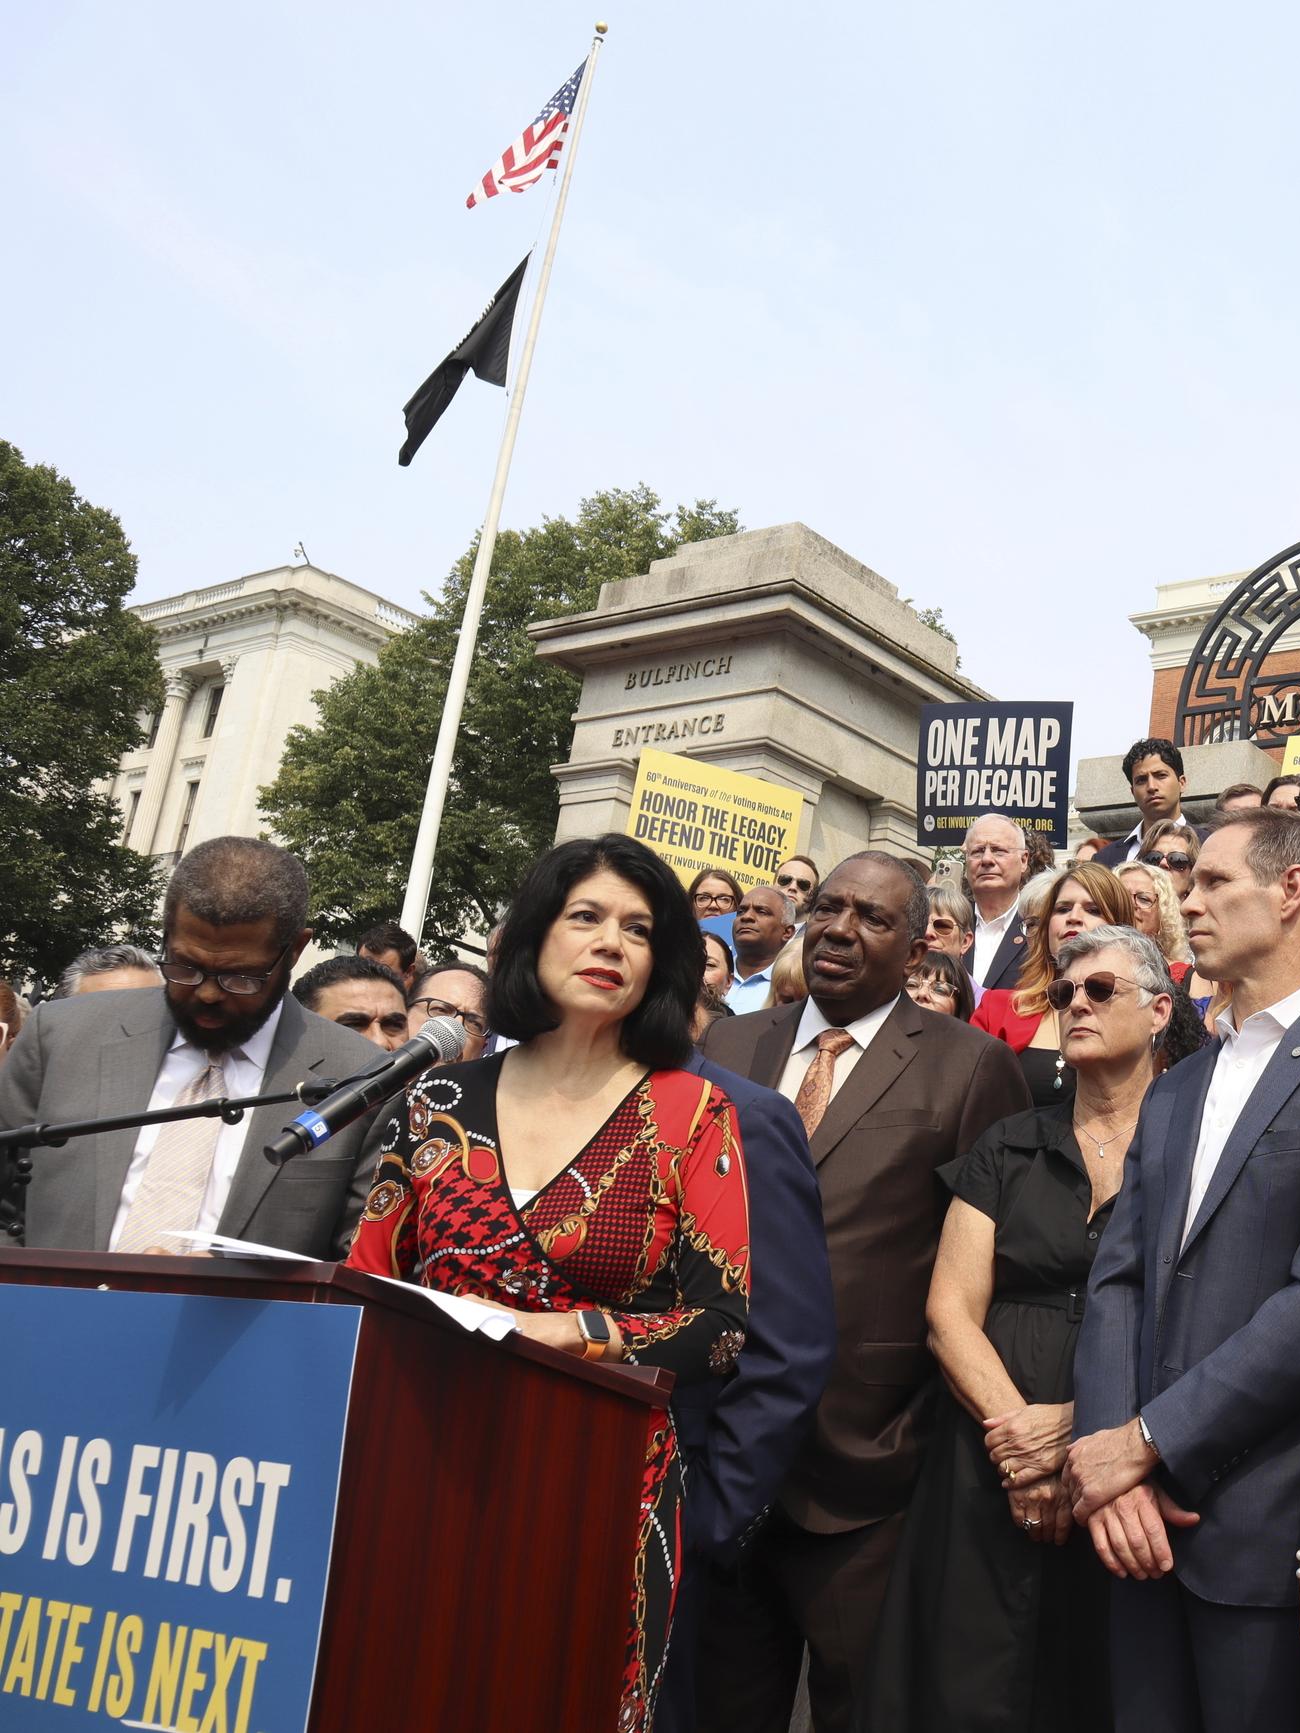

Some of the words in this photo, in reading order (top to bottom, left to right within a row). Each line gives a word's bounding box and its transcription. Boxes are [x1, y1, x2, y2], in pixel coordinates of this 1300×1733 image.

[624, 655, 733, 690] BULFINCH
[612, 713, 726, 747] ENTRANCE
[926, 717, 981, 767] ONE
[984, 717, 1061, 766] MAP
[662, 775, 709, 797] Anniversary
[709, 788, 719, 798] of
[718, 791, 733, 802] the
[733, 794, 758, 811] Voting
[757, 802, 780, 818] Rights
[780, 809, 793, 822] Act
[925, 769, 960, 807] PER
[963, 769, 1057, 809] DECADE
[634, 813, 705, 851] DEFEND
[708, 831, 740, 861] THE
[639, 789, 698, 823] HONOR
[701, 804, 729, 832] THE
[731, 813, 788, 850] LEGACY.
[936, 816, 948, 829] GET
[42, 1435, 112, 1566] IS
[112, 1444, 292, 1604] FIRST.
[87, 1611, 144, 1719] IS
[142, 1622, 268, 1733] NEXT
